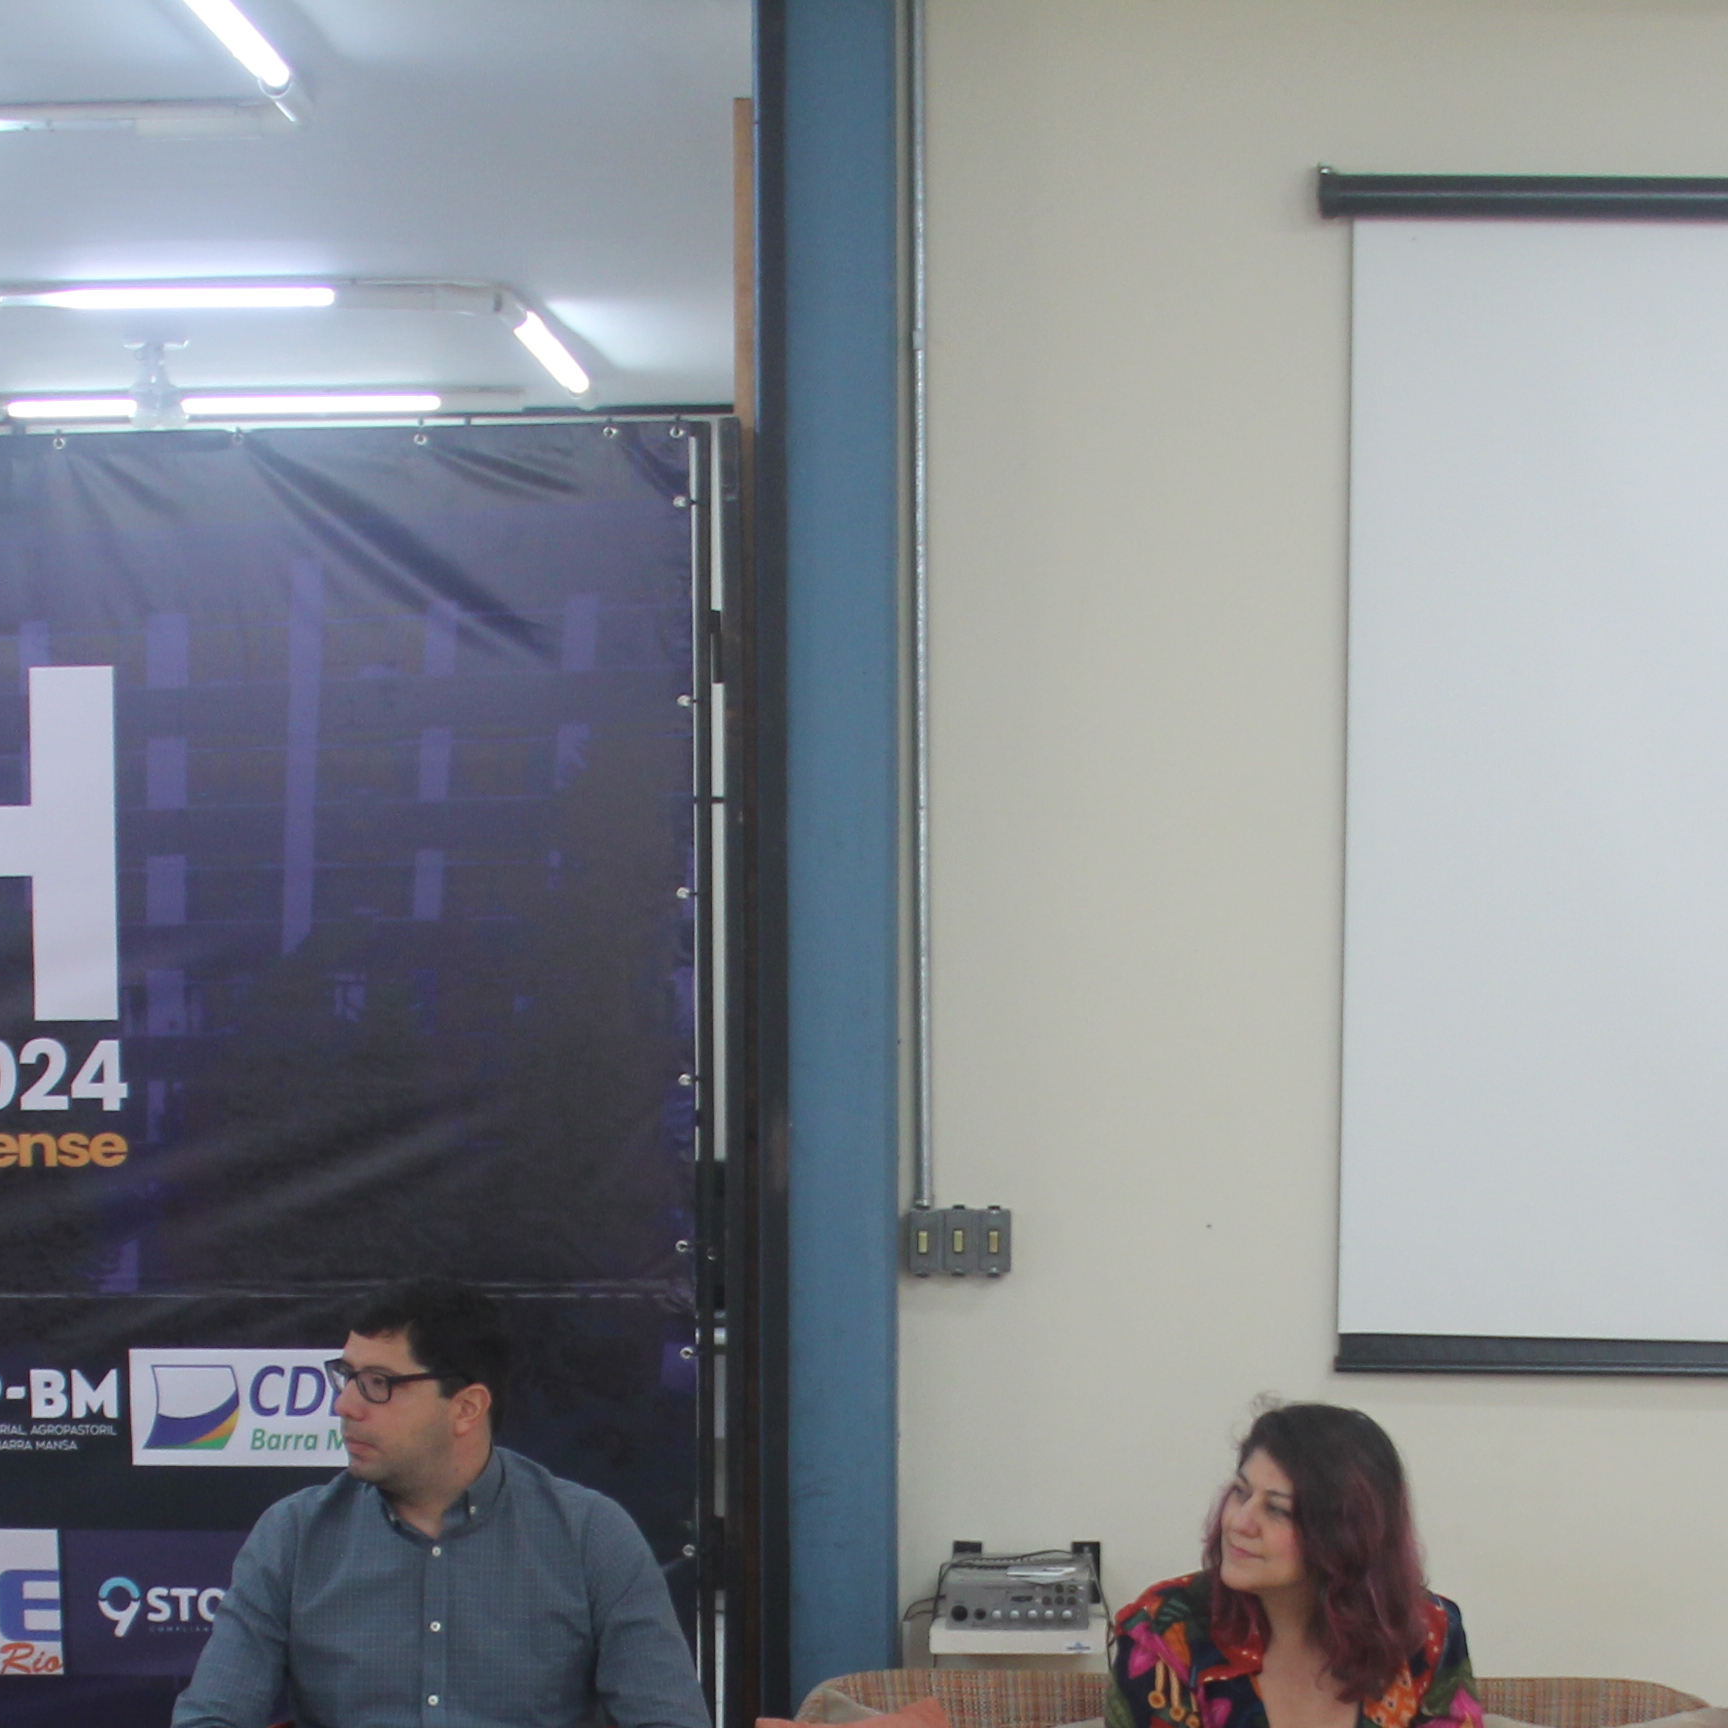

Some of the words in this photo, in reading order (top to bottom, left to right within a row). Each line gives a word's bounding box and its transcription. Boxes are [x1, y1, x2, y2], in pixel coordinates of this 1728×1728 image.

[30, 1423, 118, 1436] AGROPASTORIL
[35, 1439, 78, 1450] MANSA
[250, 1428, 318, 1450] Barra
[0, 1642, 63, 1674] Rio
